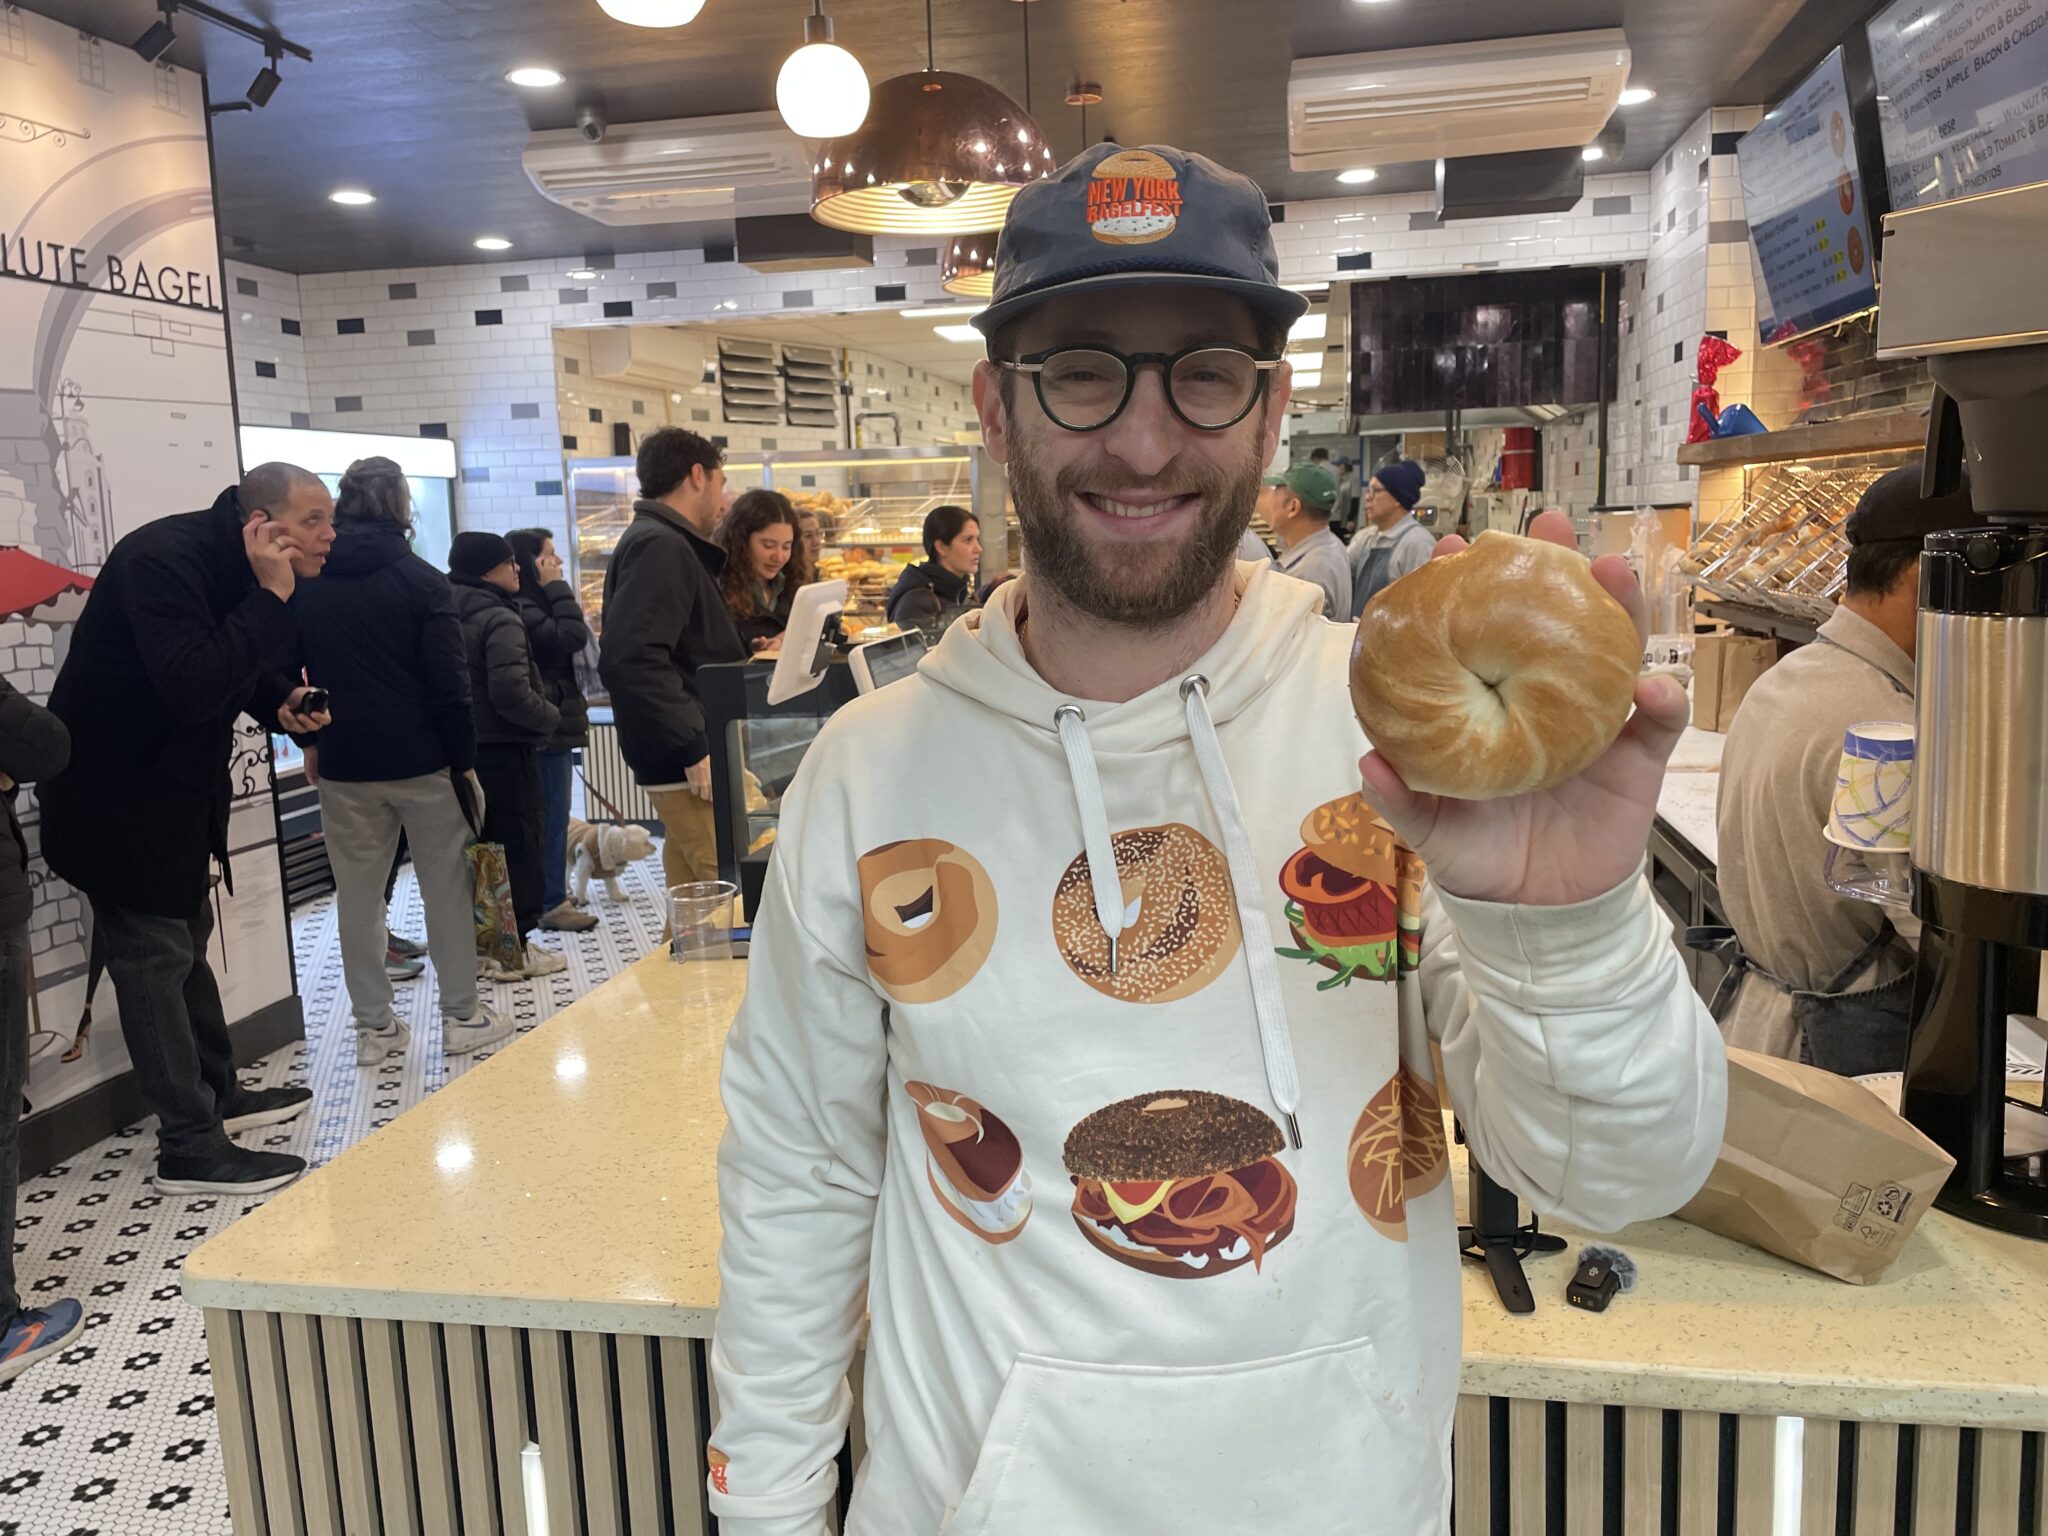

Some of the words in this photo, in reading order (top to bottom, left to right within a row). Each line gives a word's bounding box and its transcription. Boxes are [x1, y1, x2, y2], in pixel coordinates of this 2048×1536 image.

[1925, 66, 1942, 83] SUN
[1964, 23, 1997, 54] TOMATO
[1997, 15, 2005, 31] &
[2005, 0, 2032, 25] BASIL
[1946, 15, 1973, 42] RAISIN
[1946, 66, 1970, 92] APPLE
[1973, 42, 2003, 72] BACON
[2003, 36, 2011, 52] &
[1911, 150, 1944, 178] SCALLN
[2002, 92, 2040, 124] WALNUT
[2029, 119, 2036, 135] &
[1963, 164, 2002, 190] PIMENTOS
[1088, 178, 1128, 204] NEW
[1132, 178, 1180, 200] YORK
[1087, 201, 1182, 222] BAGELFEST
[1, 233, 88, 286] LUTE
